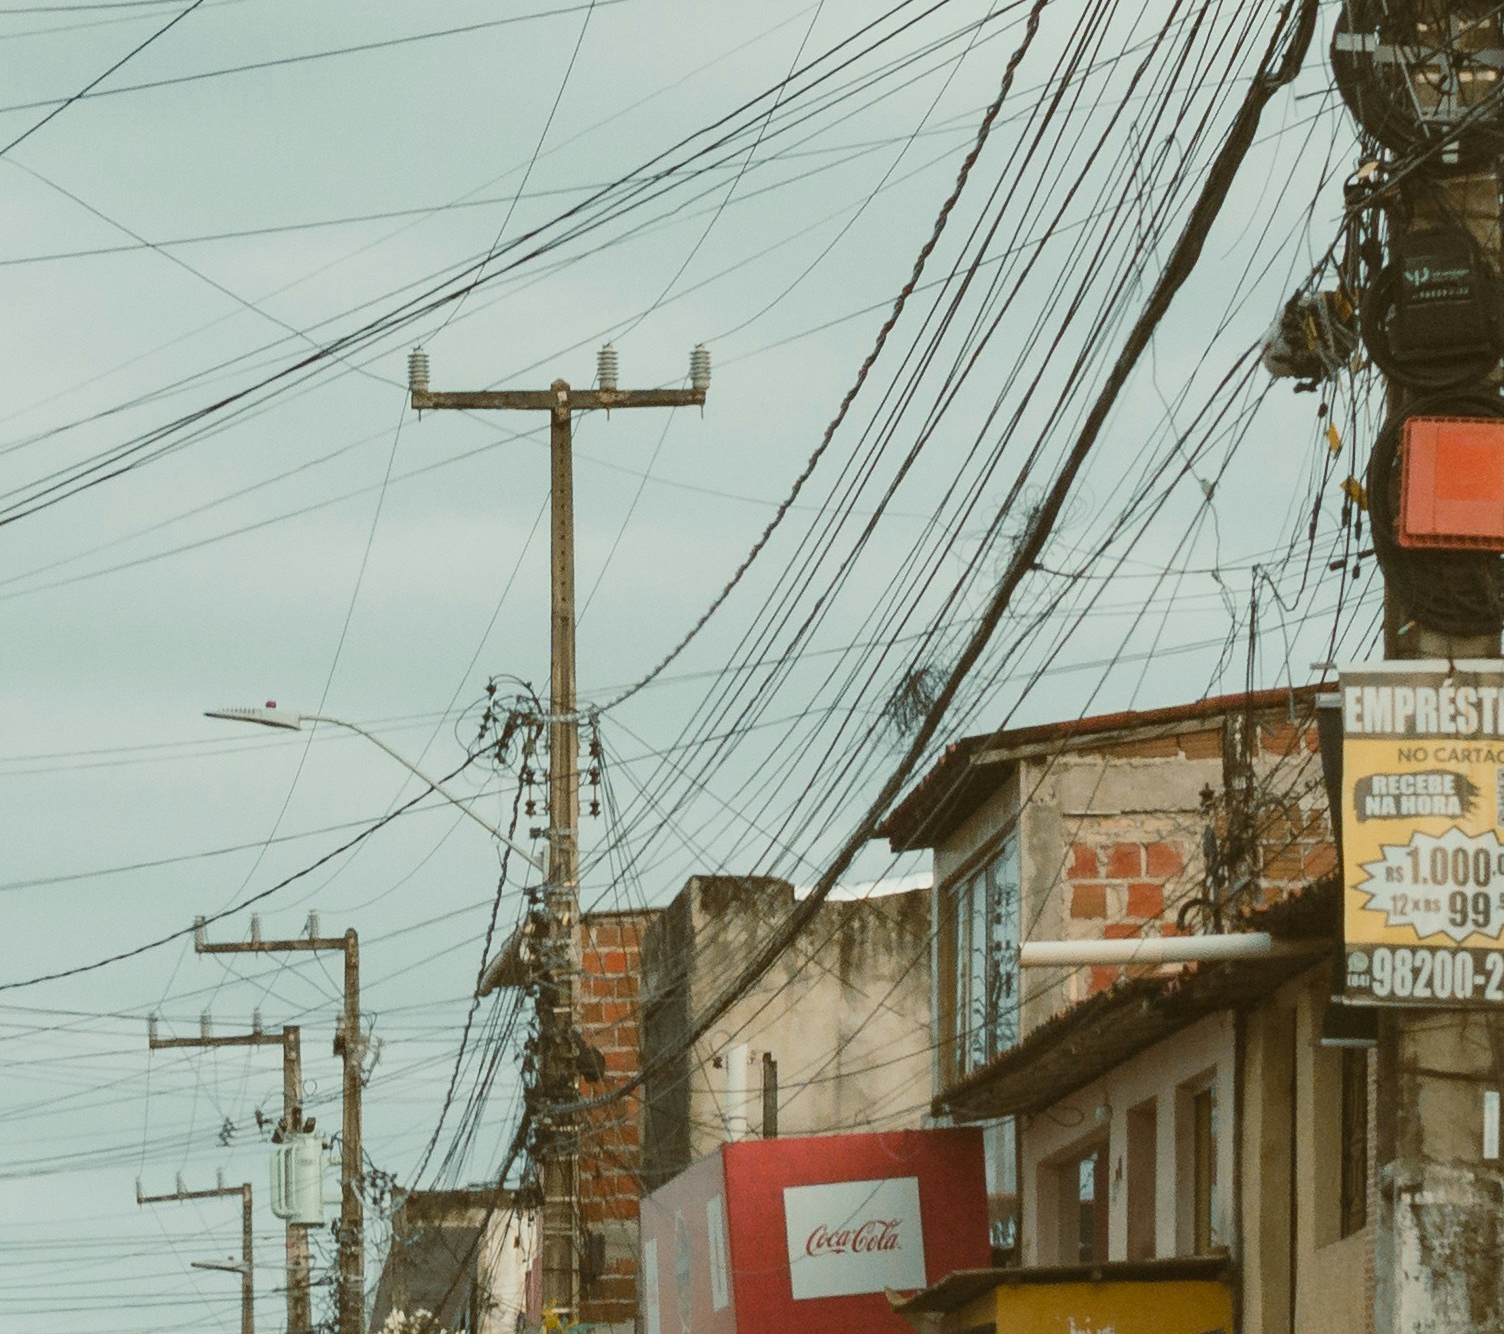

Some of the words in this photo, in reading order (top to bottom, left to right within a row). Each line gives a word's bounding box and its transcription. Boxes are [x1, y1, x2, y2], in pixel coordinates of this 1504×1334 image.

[1397, 748, 1428, 763] NO
[1372, 774, 1455, 796] RECEBE
[1365, 796, 1397, 816] NA
[1400, 795, 1462, 816] HORA
